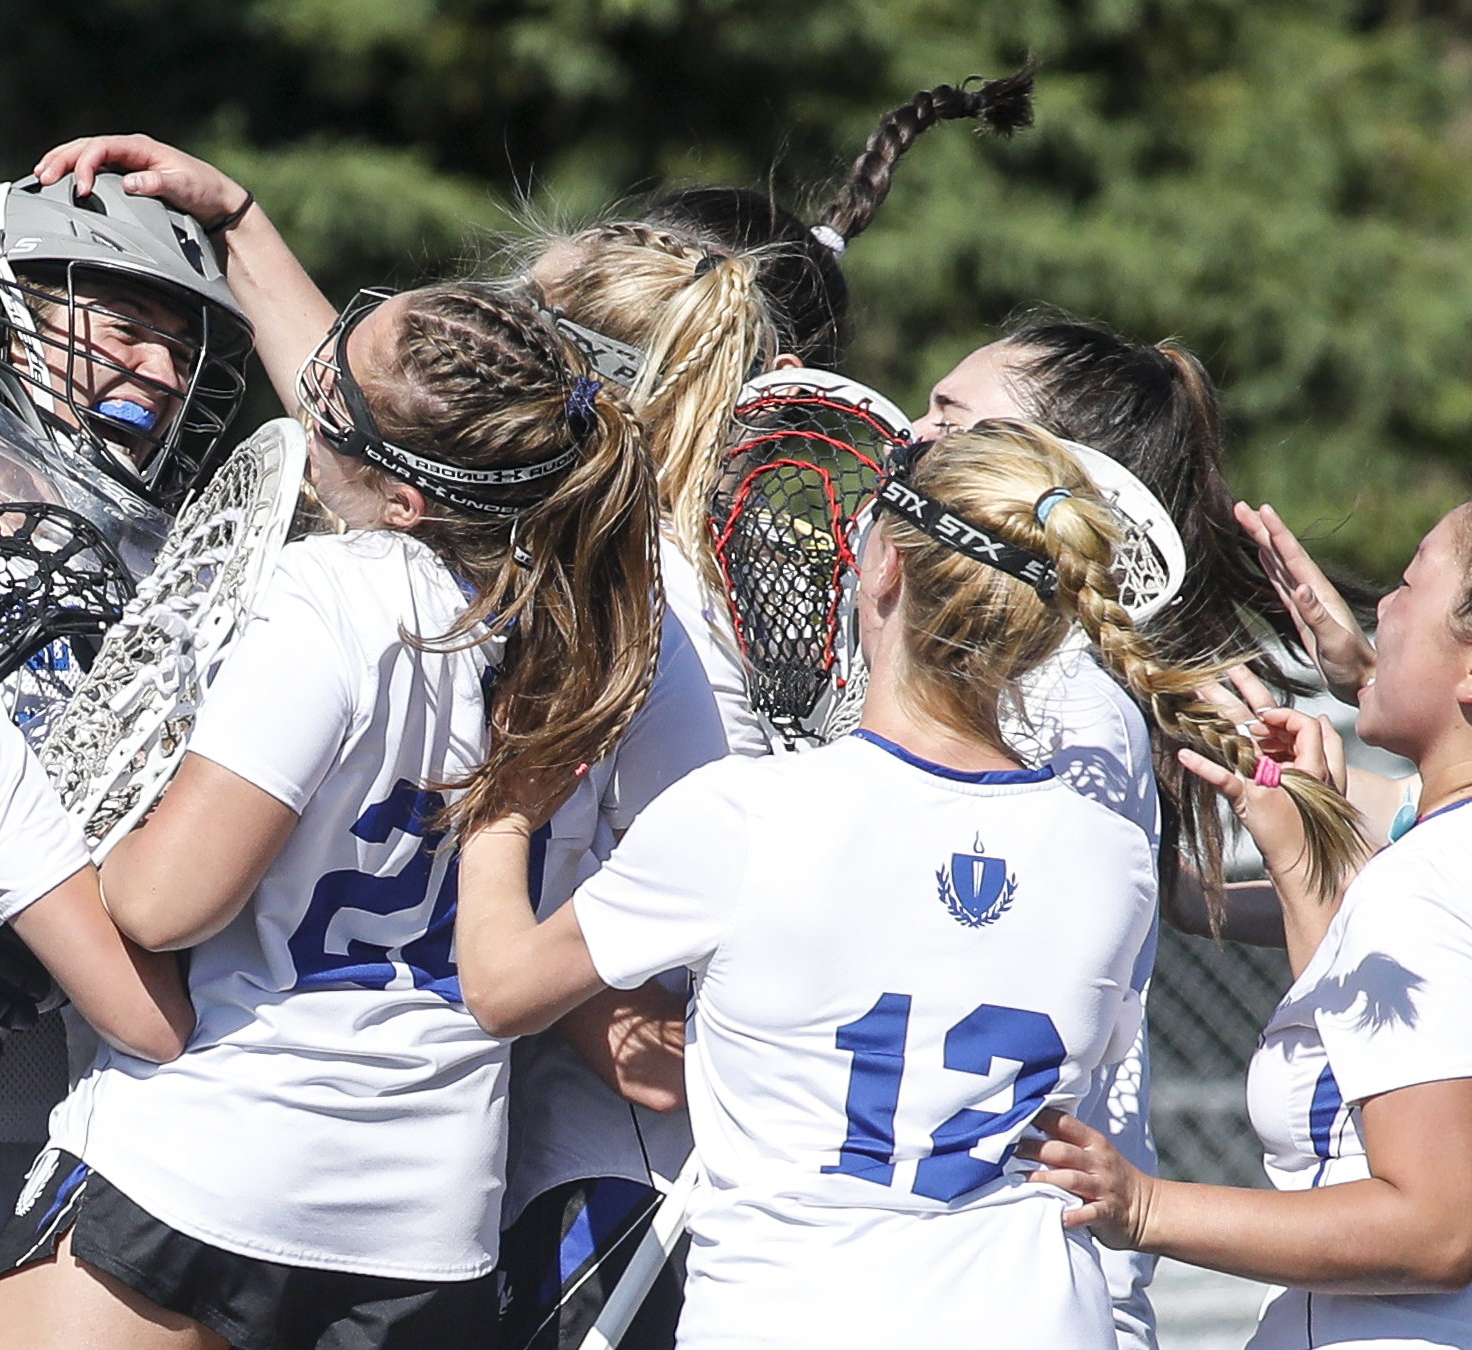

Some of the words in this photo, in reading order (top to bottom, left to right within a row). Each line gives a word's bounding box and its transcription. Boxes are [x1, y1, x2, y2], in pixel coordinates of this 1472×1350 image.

[364, 445, 411, 479] OUR
[882, 481, 928, 519] STX
[935, 513, 1006, 562] STX
[820, 992, 1067, 1204] 12
